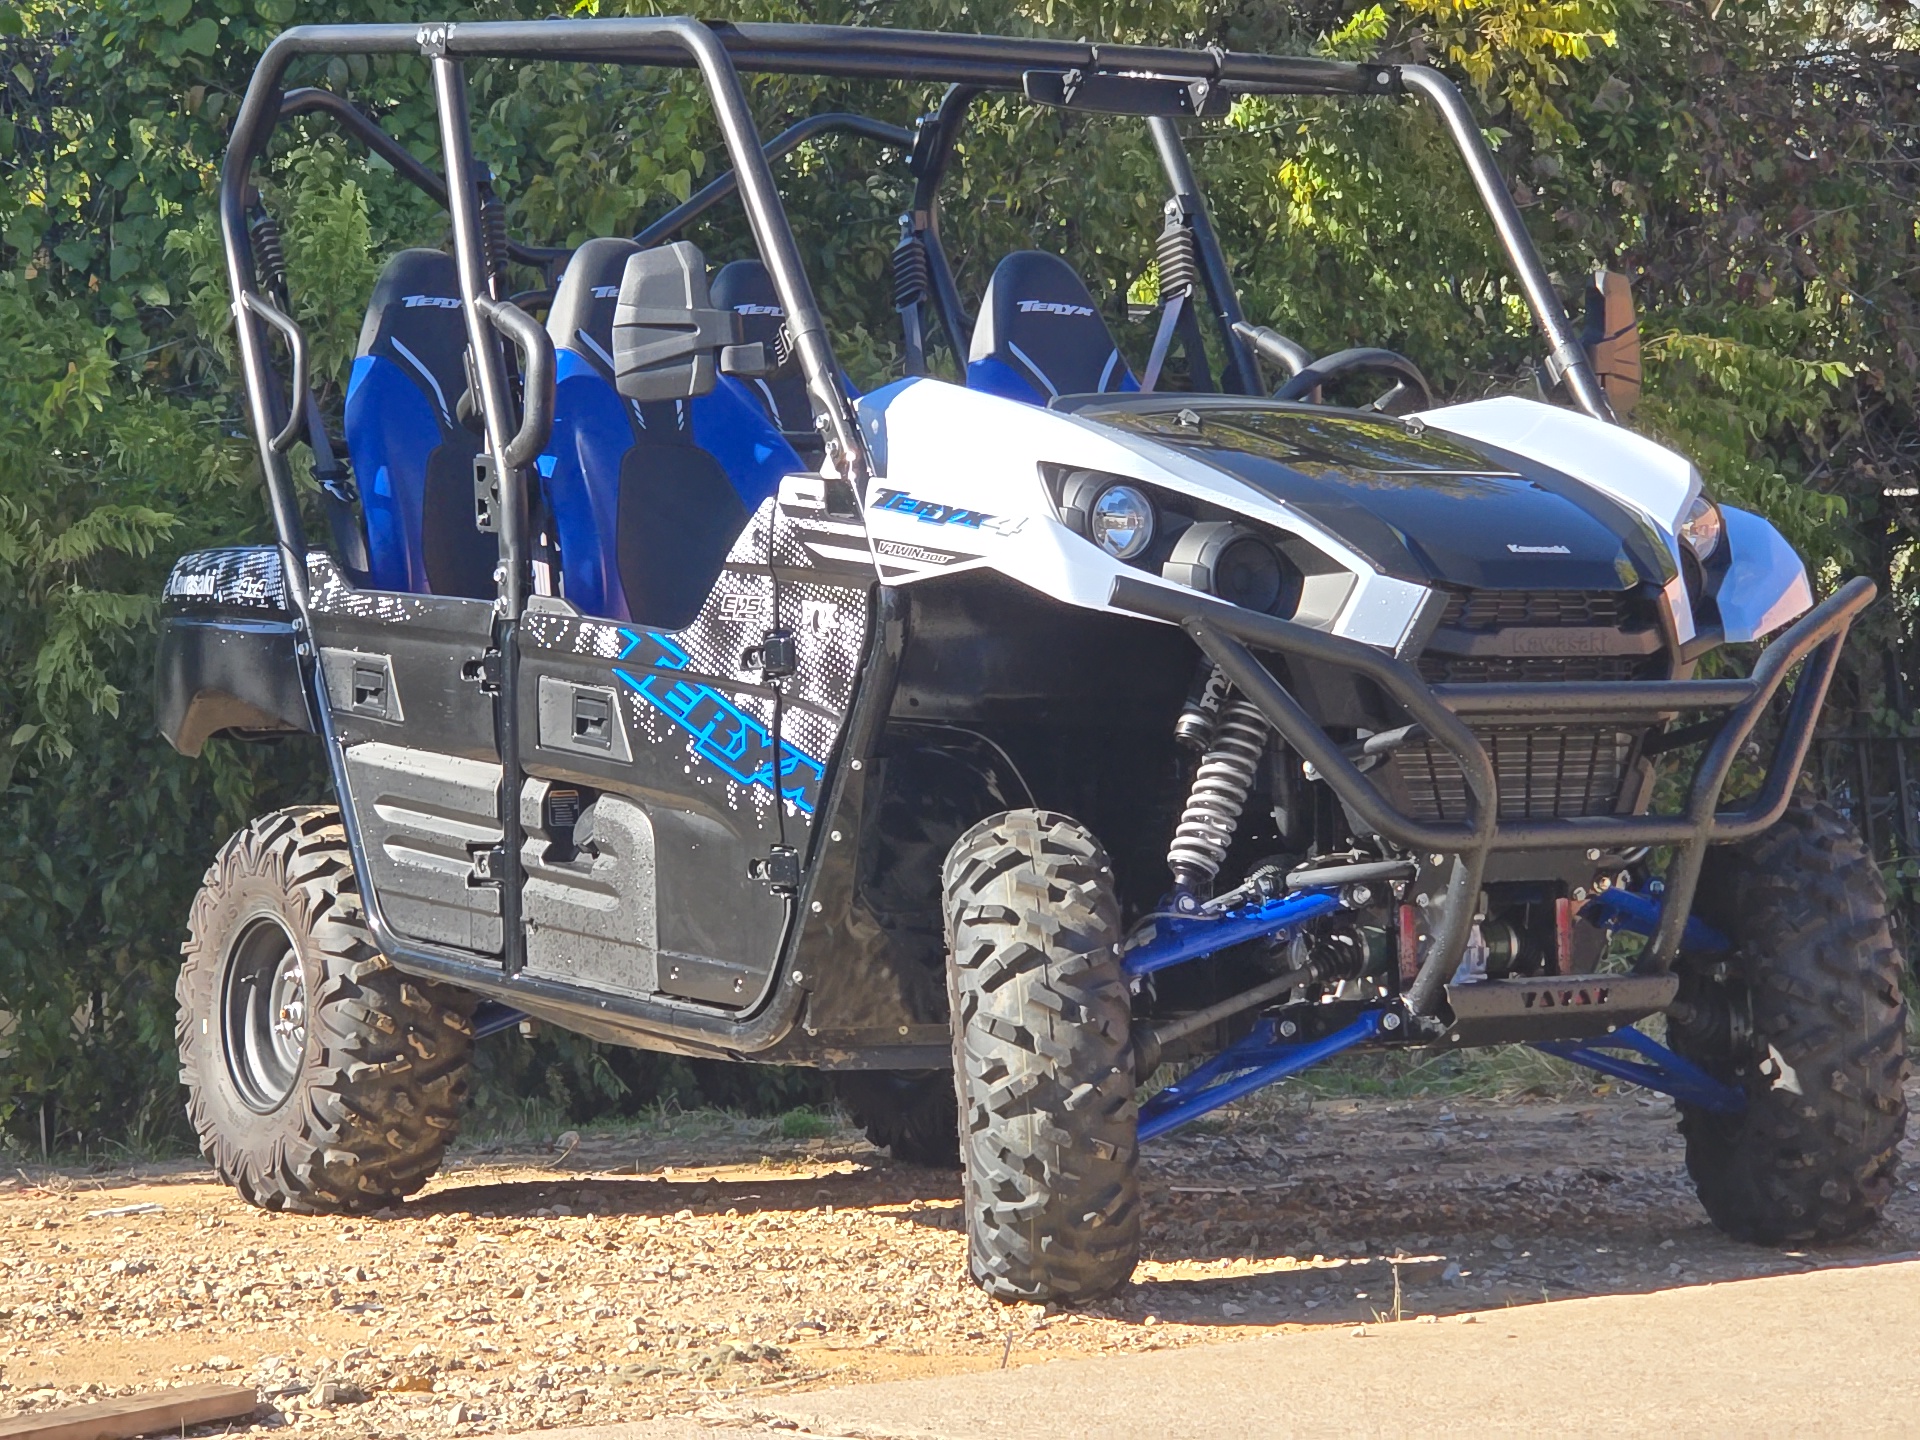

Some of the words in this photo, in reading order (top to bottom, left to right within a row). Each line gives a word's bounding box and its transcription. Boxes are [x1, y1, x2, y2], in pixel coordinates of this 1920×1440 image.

[401, 294, 463, 309] TERY
[169, 568, 217, 596] Kawasaki
[722, 595, 762, 617] EPS
[1512, 630, 1609, 654] Kawasaki
